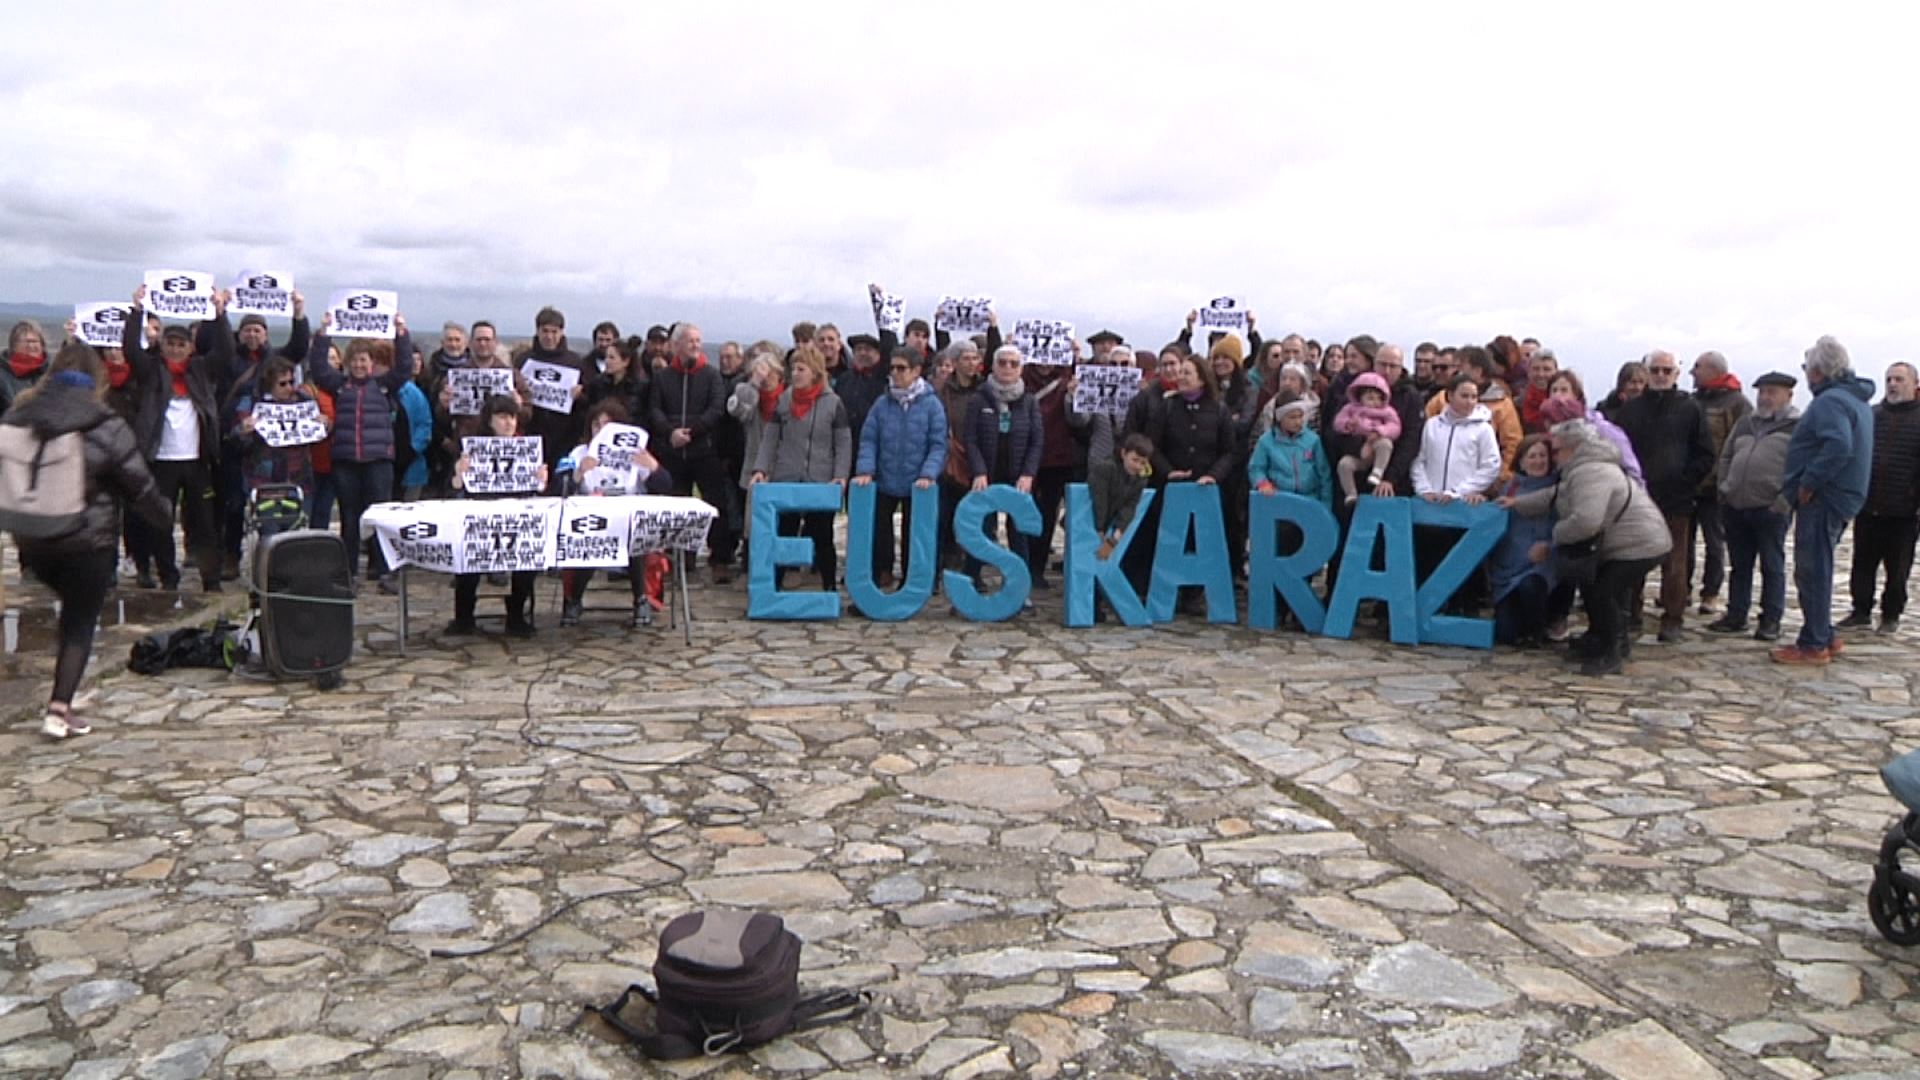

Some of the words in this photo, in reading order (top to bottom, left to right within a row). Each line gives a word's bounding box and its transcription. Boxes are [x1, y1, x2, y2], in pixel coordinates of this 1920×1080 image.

[1031, 334, 1052, 348] 17
[1097, 384, 1118, 397] 17
[489, 458, 515, 473] 17
[491, 532, 518, 550] 17
[746, 482, 1509, 649] EUSKARAZ
